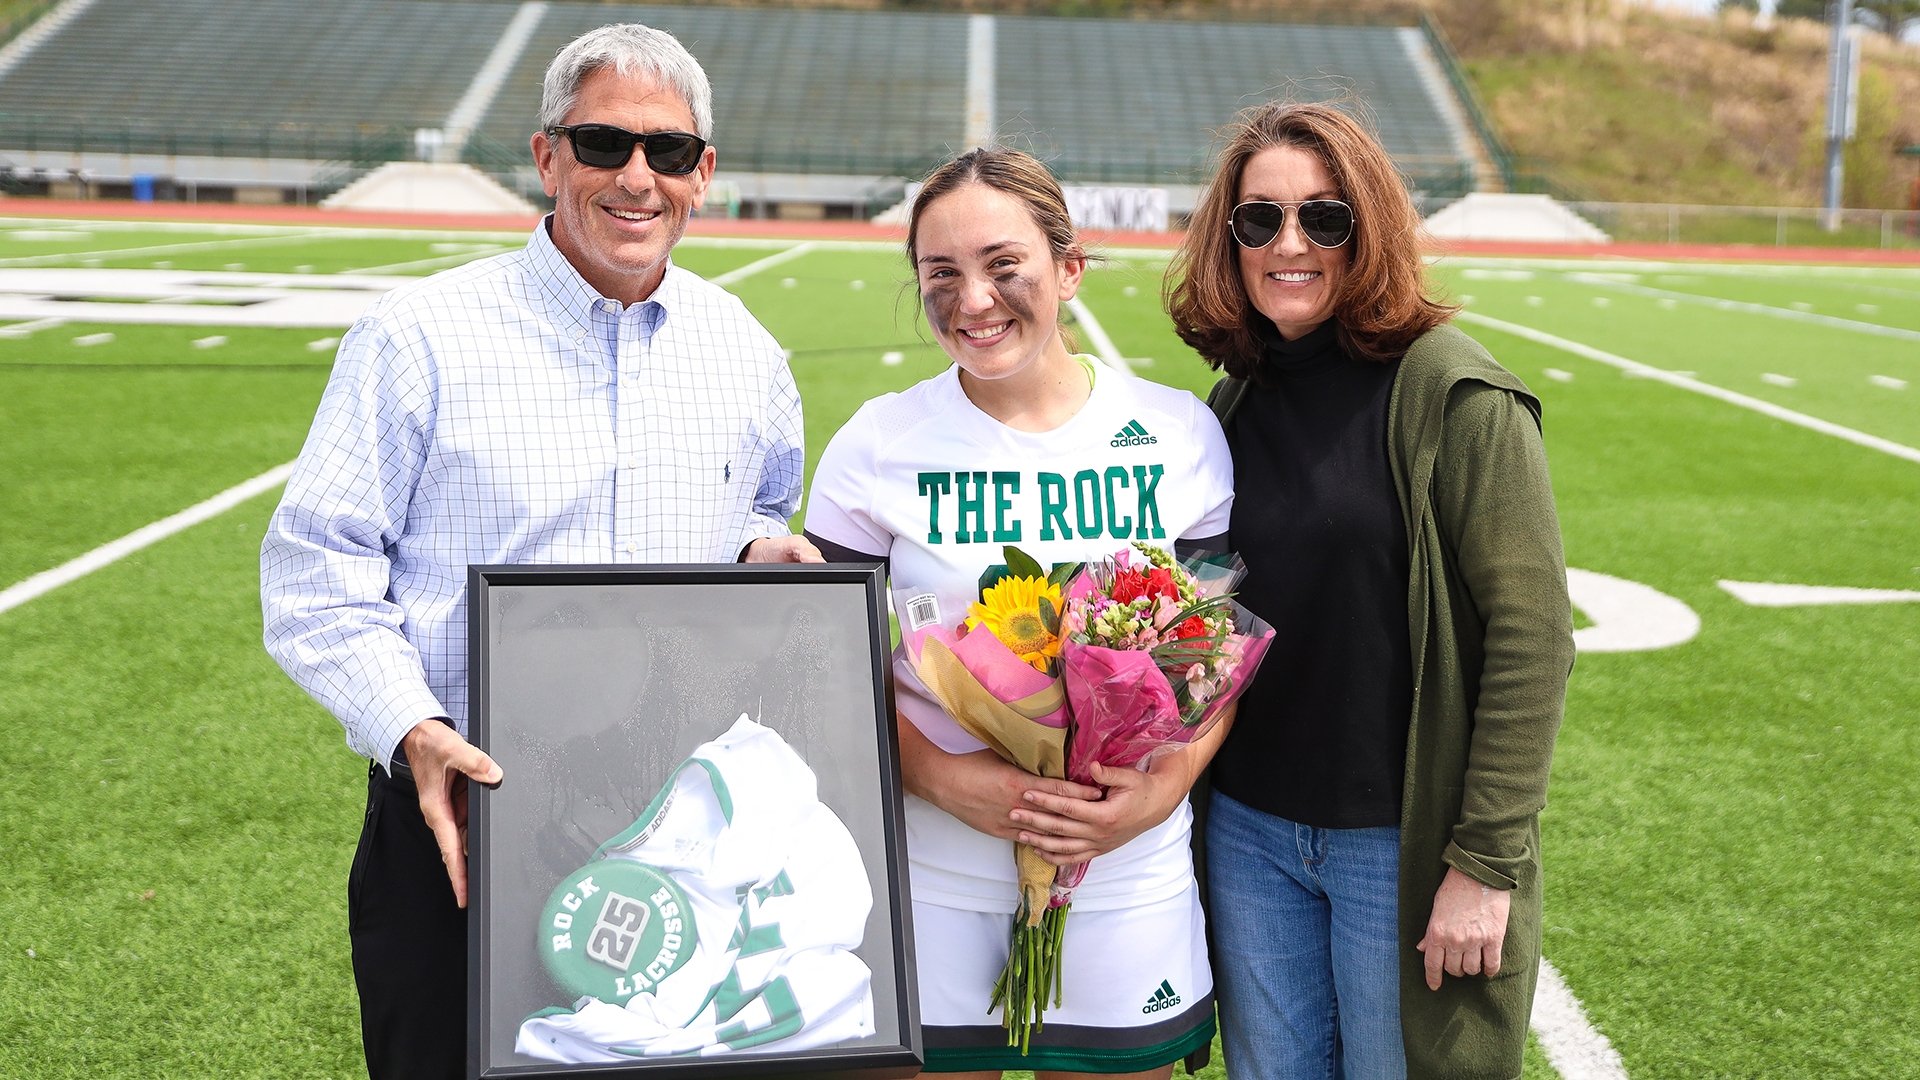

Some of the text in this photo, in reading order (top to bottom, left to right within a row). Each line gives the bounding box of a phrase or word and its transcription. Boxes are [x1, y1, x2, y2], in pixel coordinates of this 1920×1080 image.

[1110, 434, 1158, 448] adidas
[917, 463, 1167, 545] THE ROCK
[651, 799, 673, 833] ADIDAS
[552, 875, 600, 953] ROCK
[588, 893, 649, 968] 25
[614, 886, 683, 997] LACROSSE
[1142, 995, 1181, 1015] adidas
